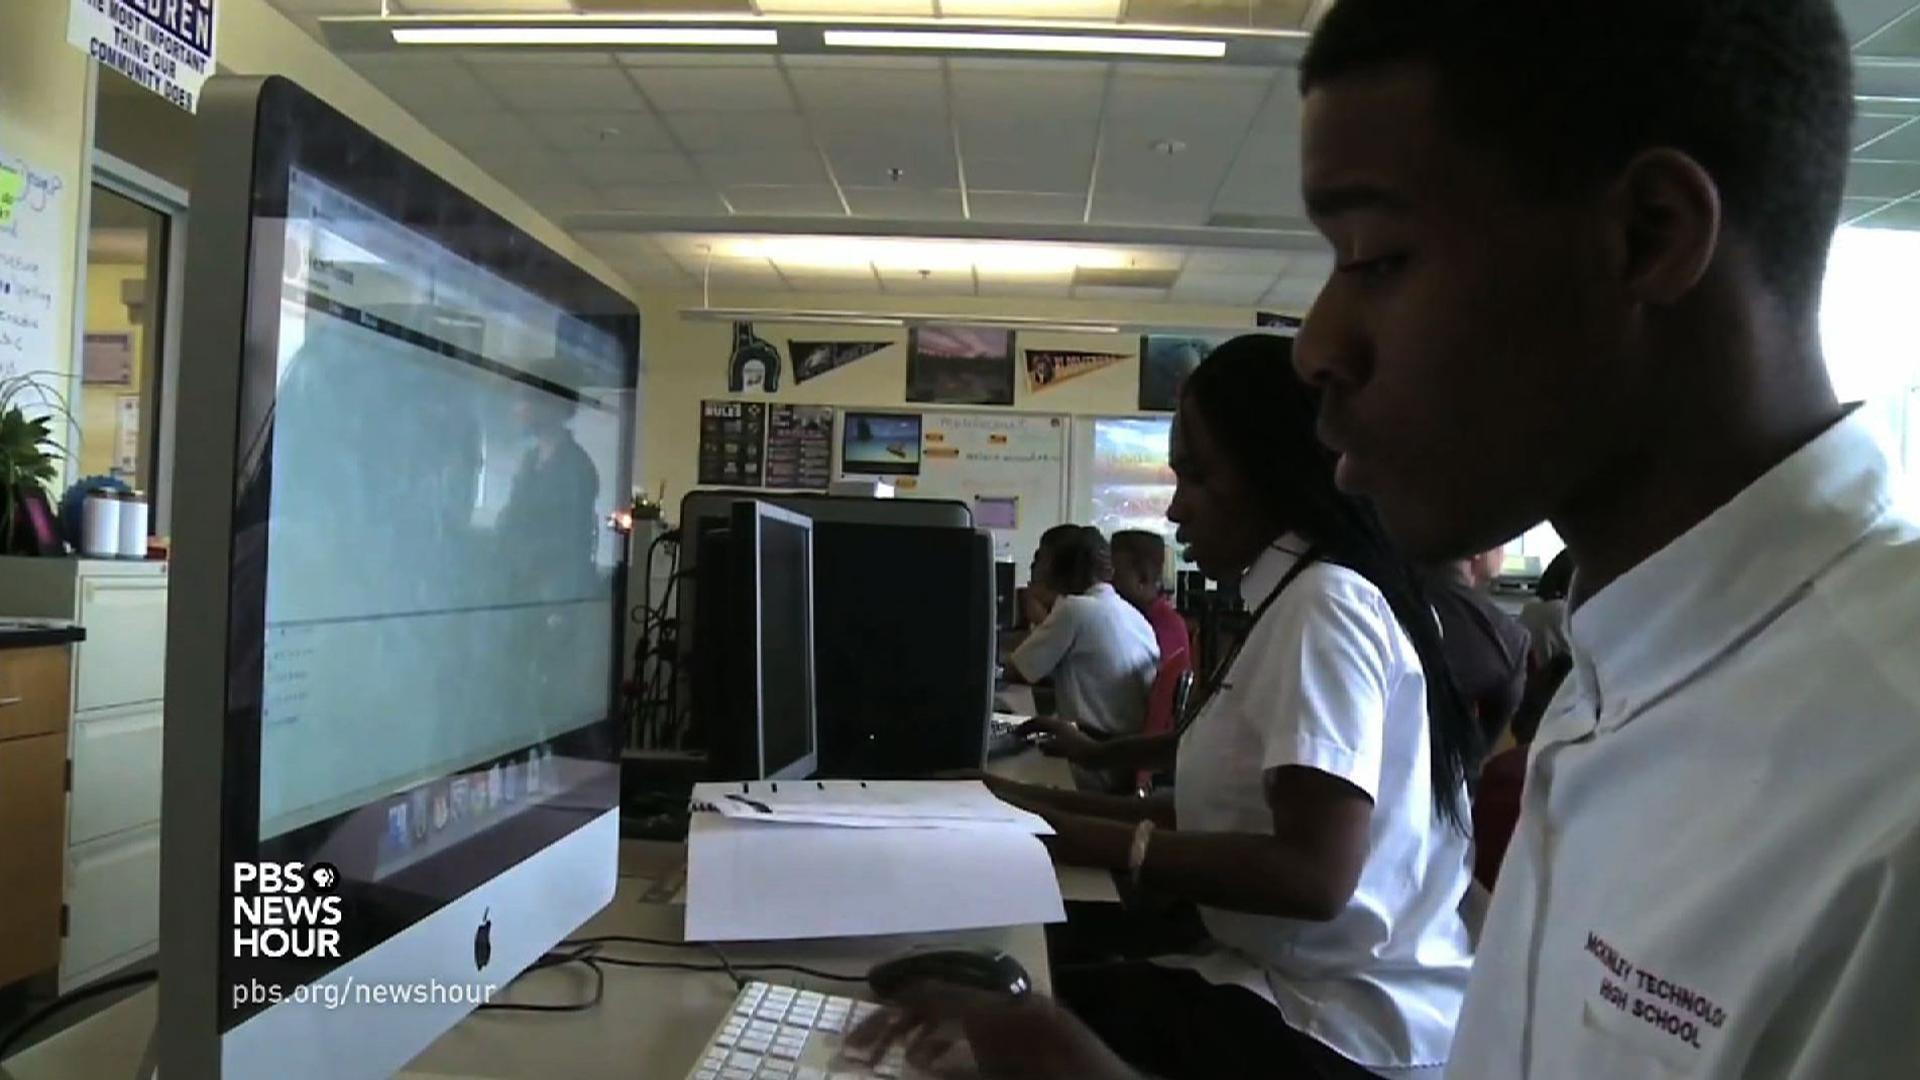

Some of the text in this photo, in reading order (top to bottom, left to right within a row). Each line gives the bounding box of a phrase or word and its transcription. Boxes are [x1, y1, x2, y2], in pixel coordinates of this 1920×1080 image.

[90, 36, 193, 111] COMMUNITY DOES
[109, 1, 141, 35] MOST
[145, 22, 206, 74] IMPORTANT
[114, 26, 176, 79] THING OUR
[1600, 977, 1701, 1049] HIGH SCHOOL
